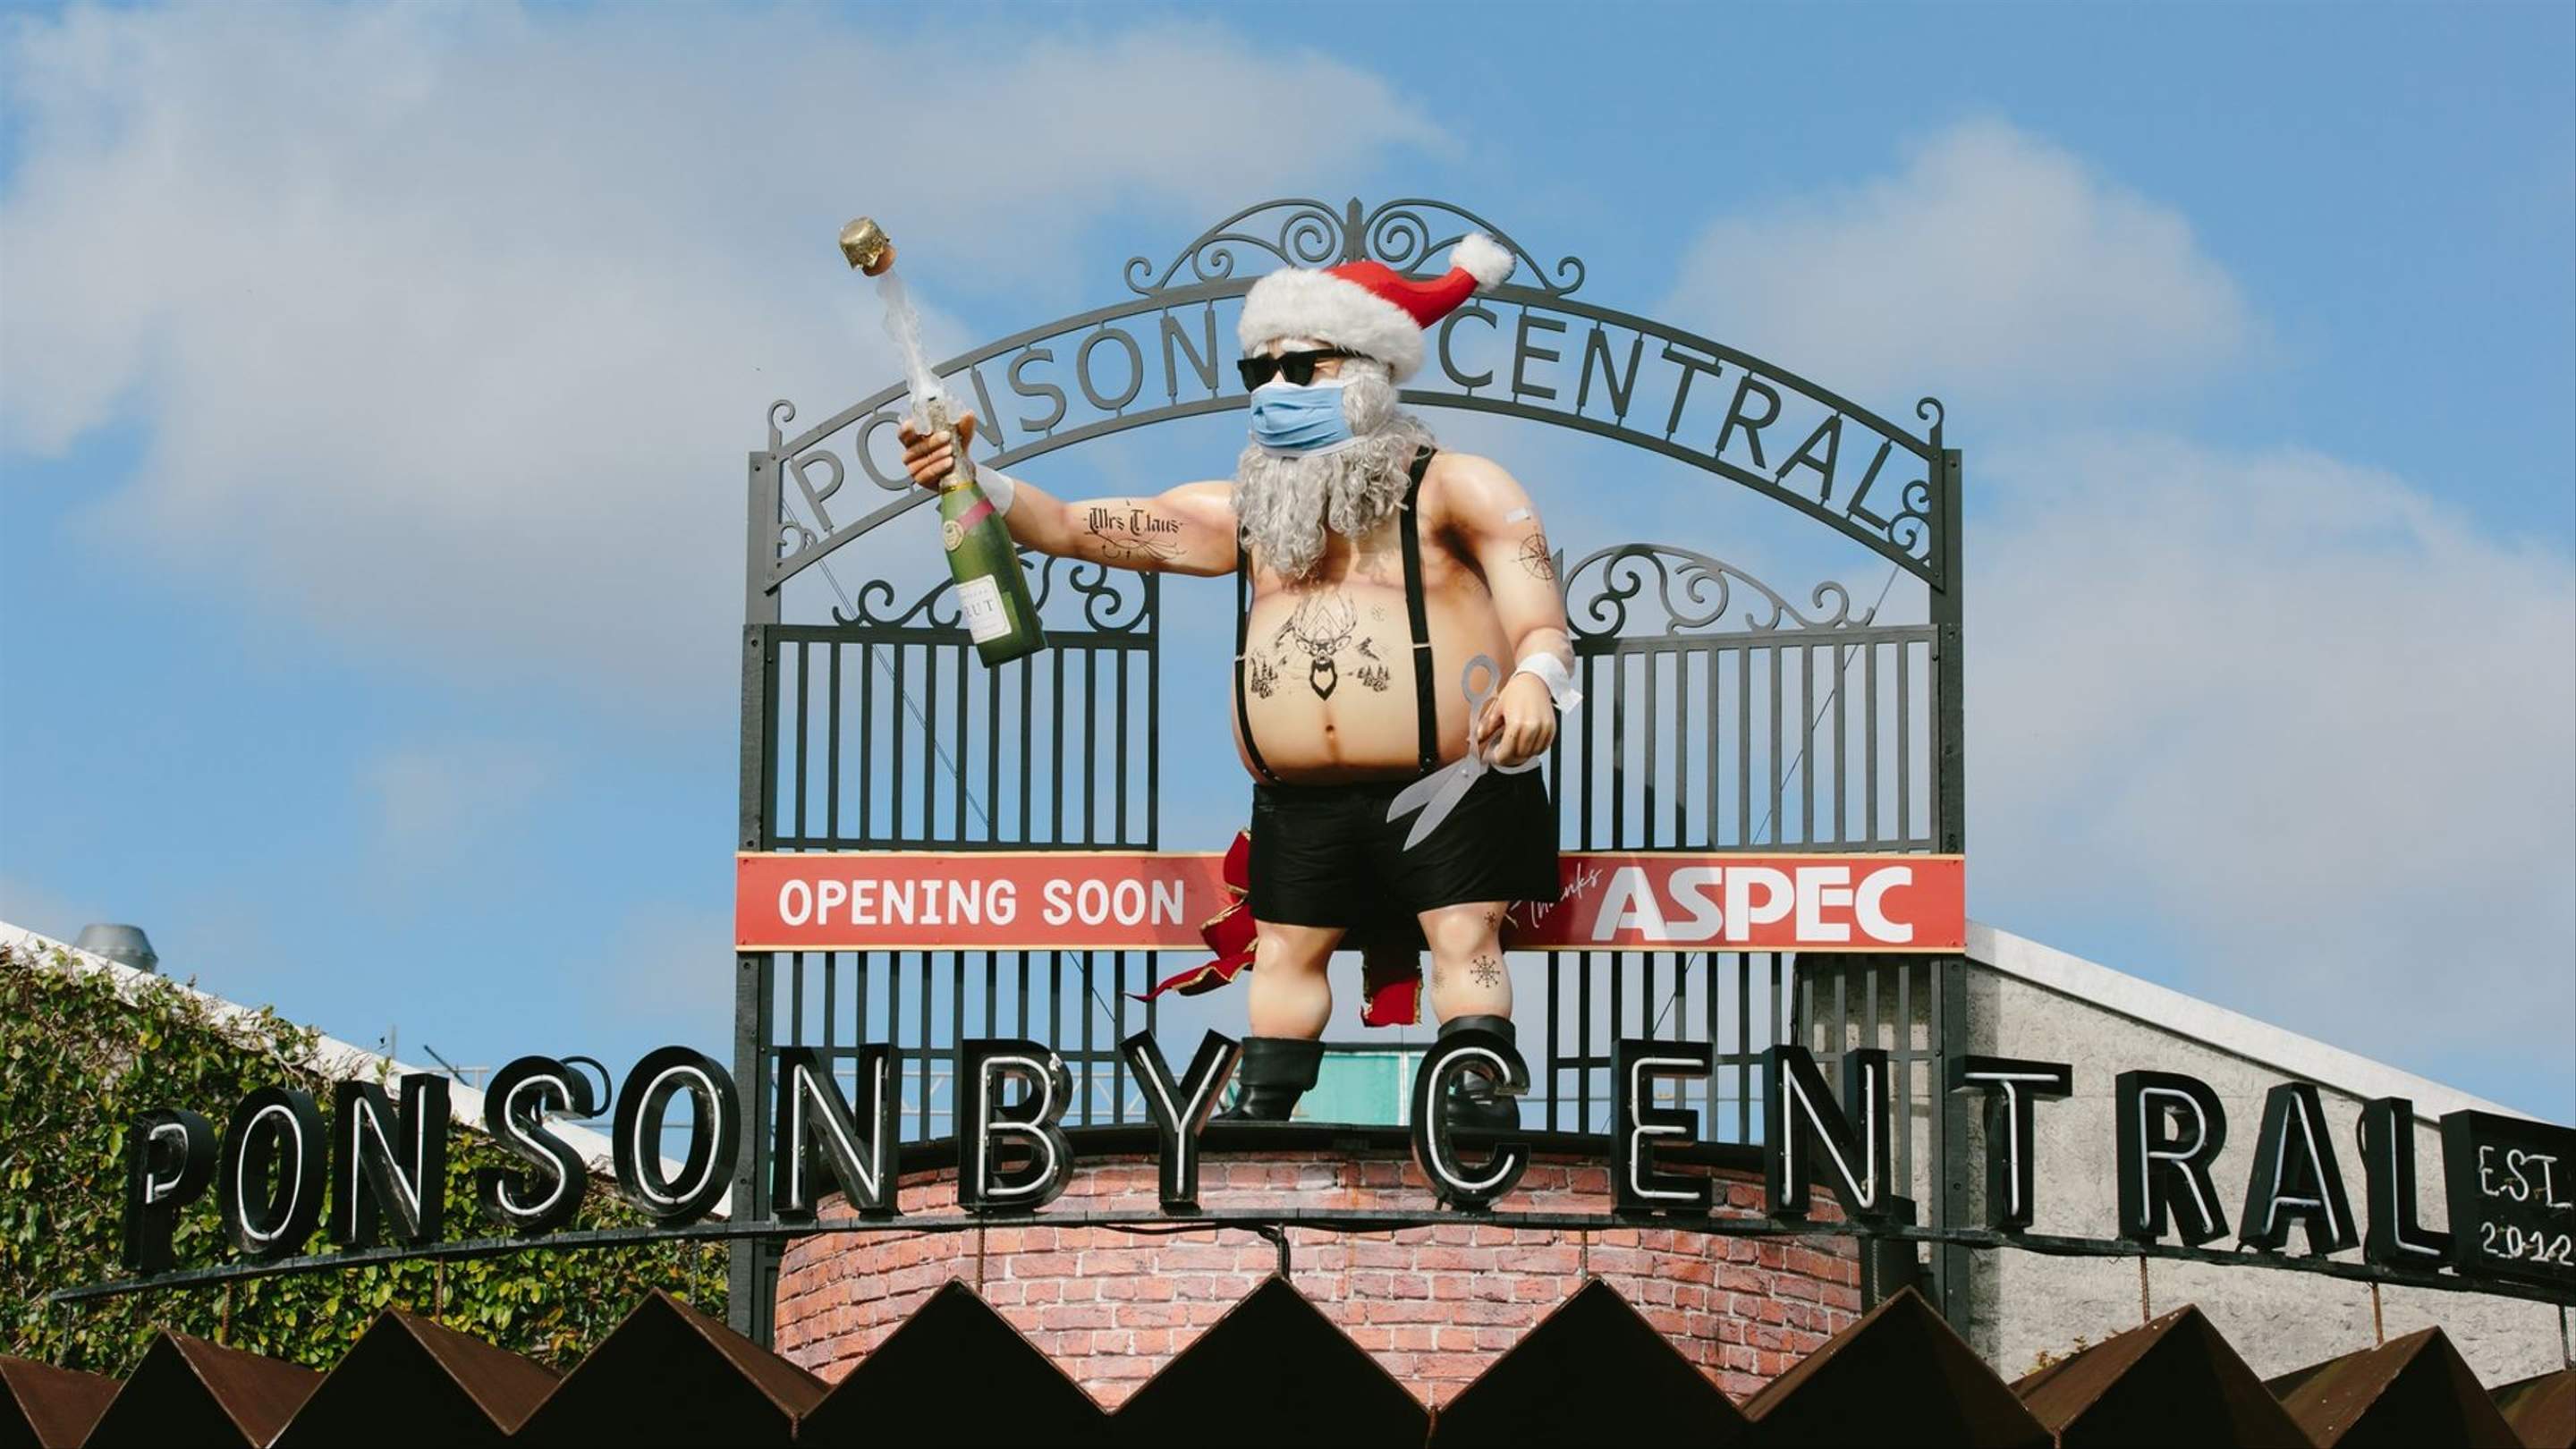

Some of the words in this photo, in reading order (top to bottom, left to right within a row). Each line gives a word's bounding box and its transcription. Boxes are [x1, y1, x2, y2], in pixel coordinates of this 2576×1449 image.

[789, 309, 1219, 532] POSON
[1438, 306, 1889, 530] CENTRAL
[779, 878, 1016, 927] OPENING
[1042, 878, 1184, 927] SOON
[1591, 866, 1912, 943] ASPEC
[123, 1029, 1245, 1271] PONSONBY
[1411, 1029, 2456, 1267] CENTRAL
[2480, 1221, 2575, 1267] 2012
